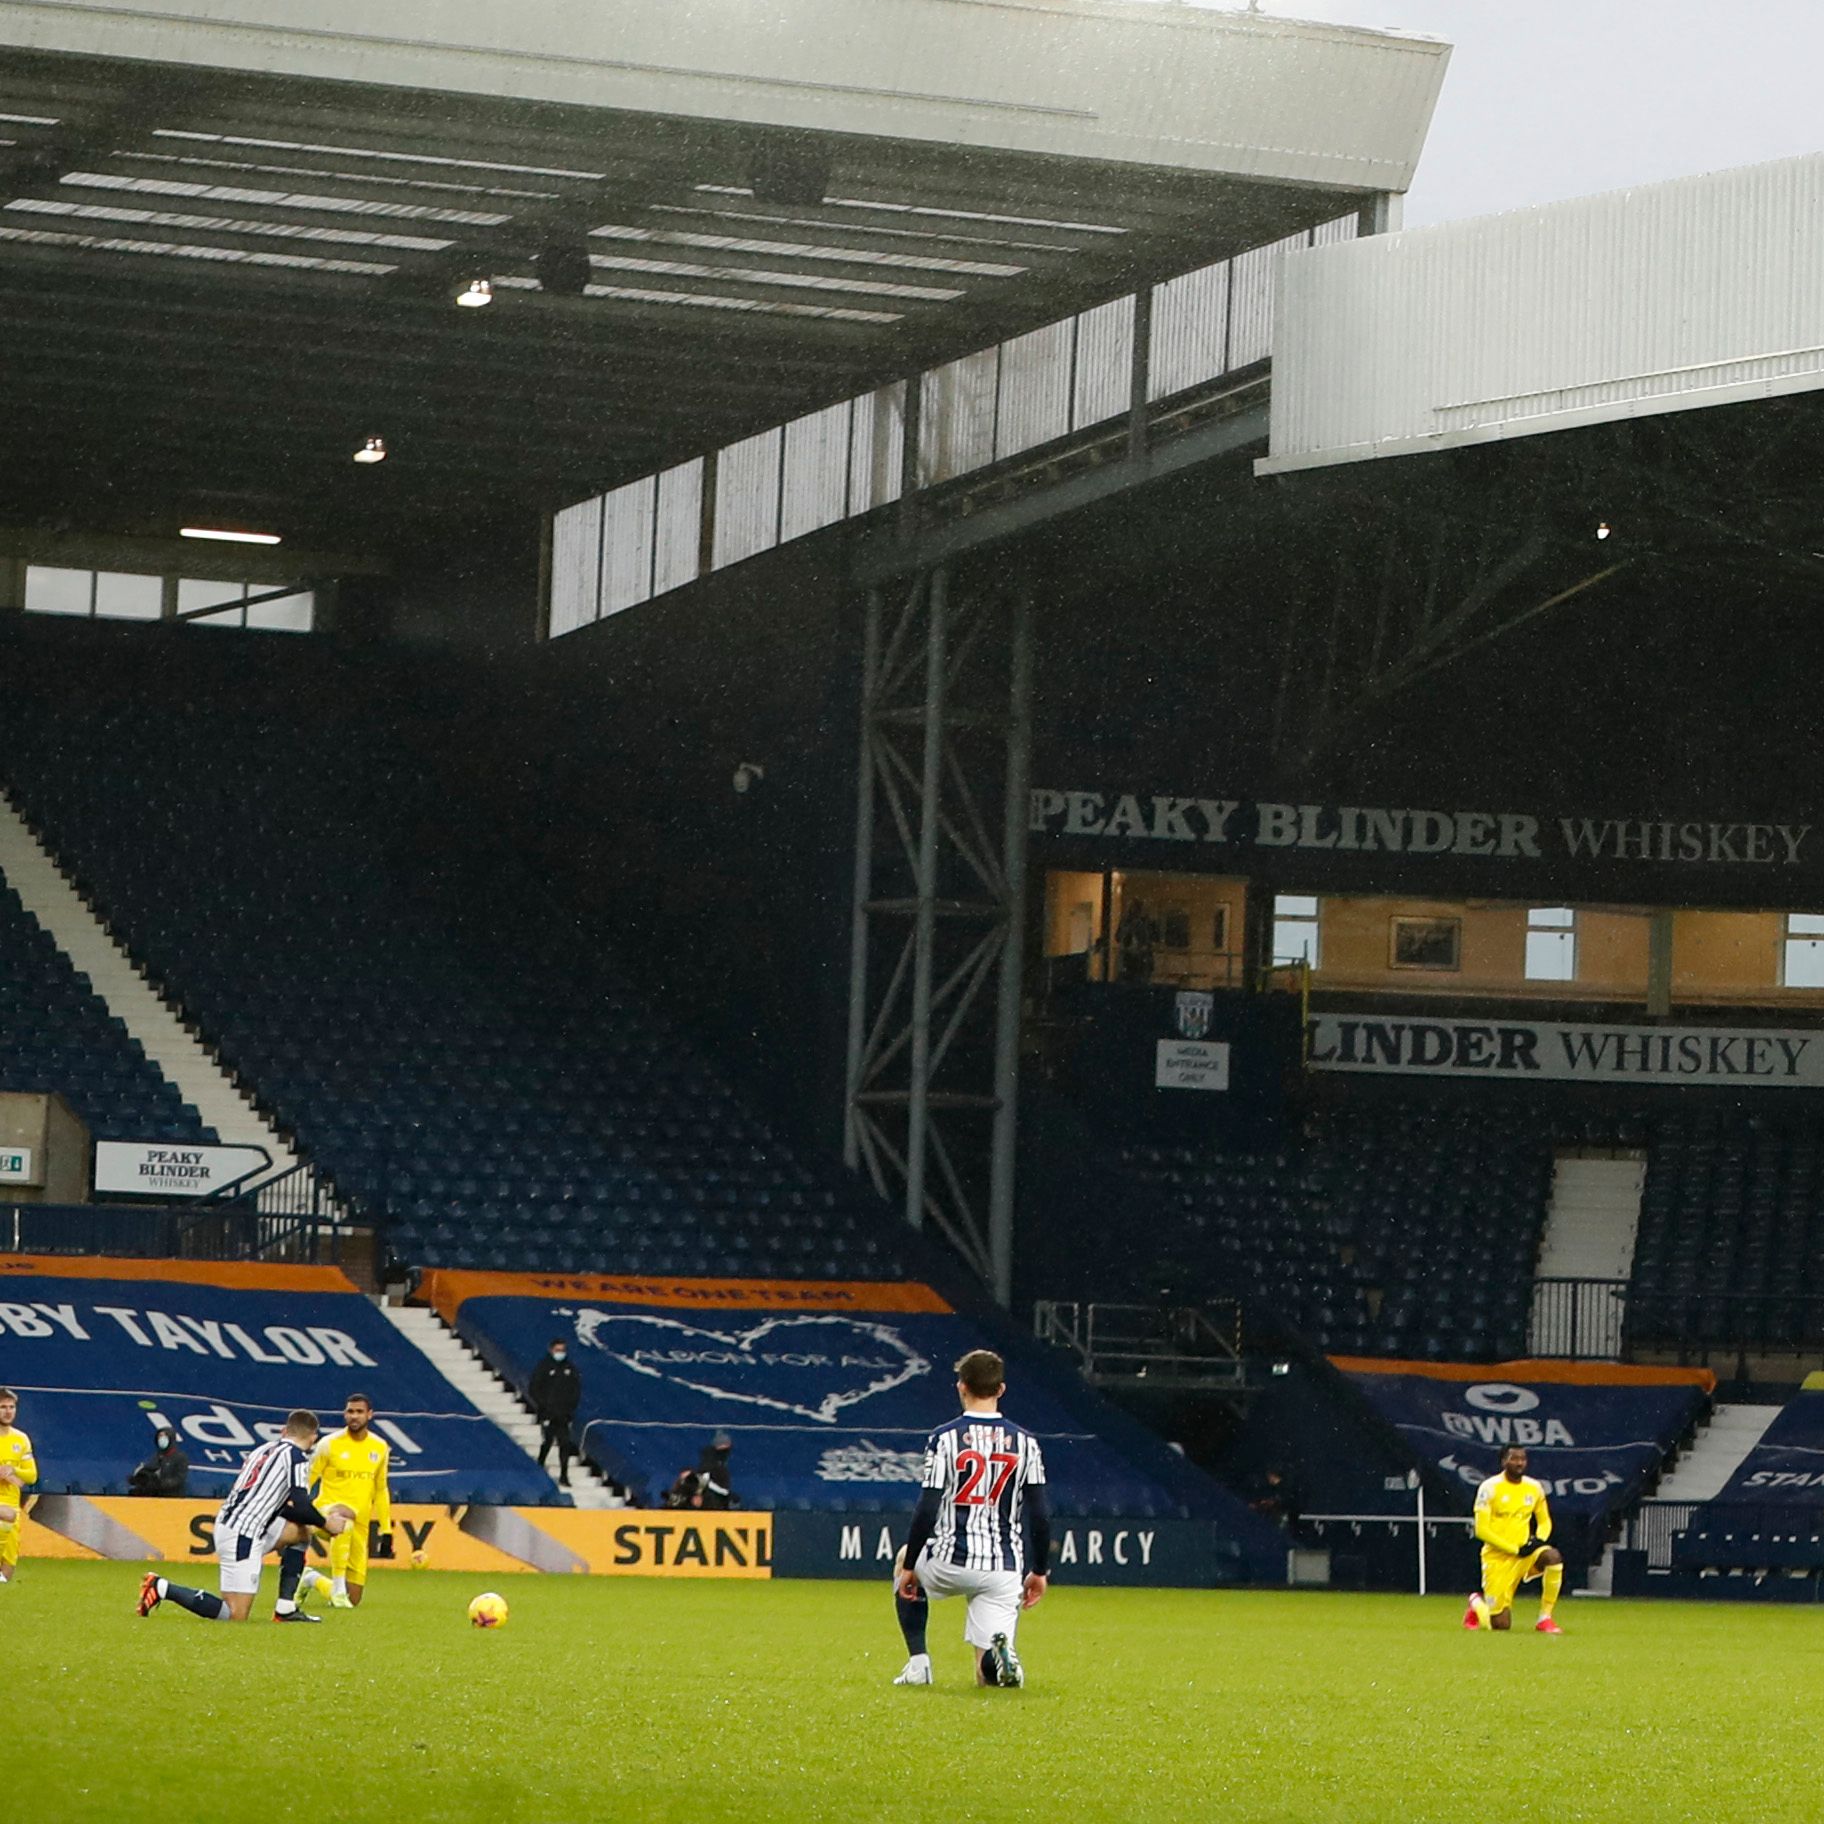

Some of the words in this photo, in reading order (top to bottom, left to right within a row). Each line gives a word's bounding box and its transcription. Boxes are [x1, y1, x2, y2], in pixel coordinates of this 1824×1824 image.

[1030, 788, 1240, 843] PEAKY
[1254, 802, 1541, 858] BLINDER
[1559, 817, 1811, 865] WHISKEY
[1559, 1031, 1809, 1077] WHISKEY
[139, 1163, 210, 1178] BLINDER
[147, 1150, 204, 1164] PEAKY
[149, 1177, 200, 1188] WHISKEY
[0, 1303, 90, 1340] BY
[94, 1306, 378, 1368] TAYLOR
[138, 1401, 422, 1455] idel
[952, 1448, 1020, 1508] 27
